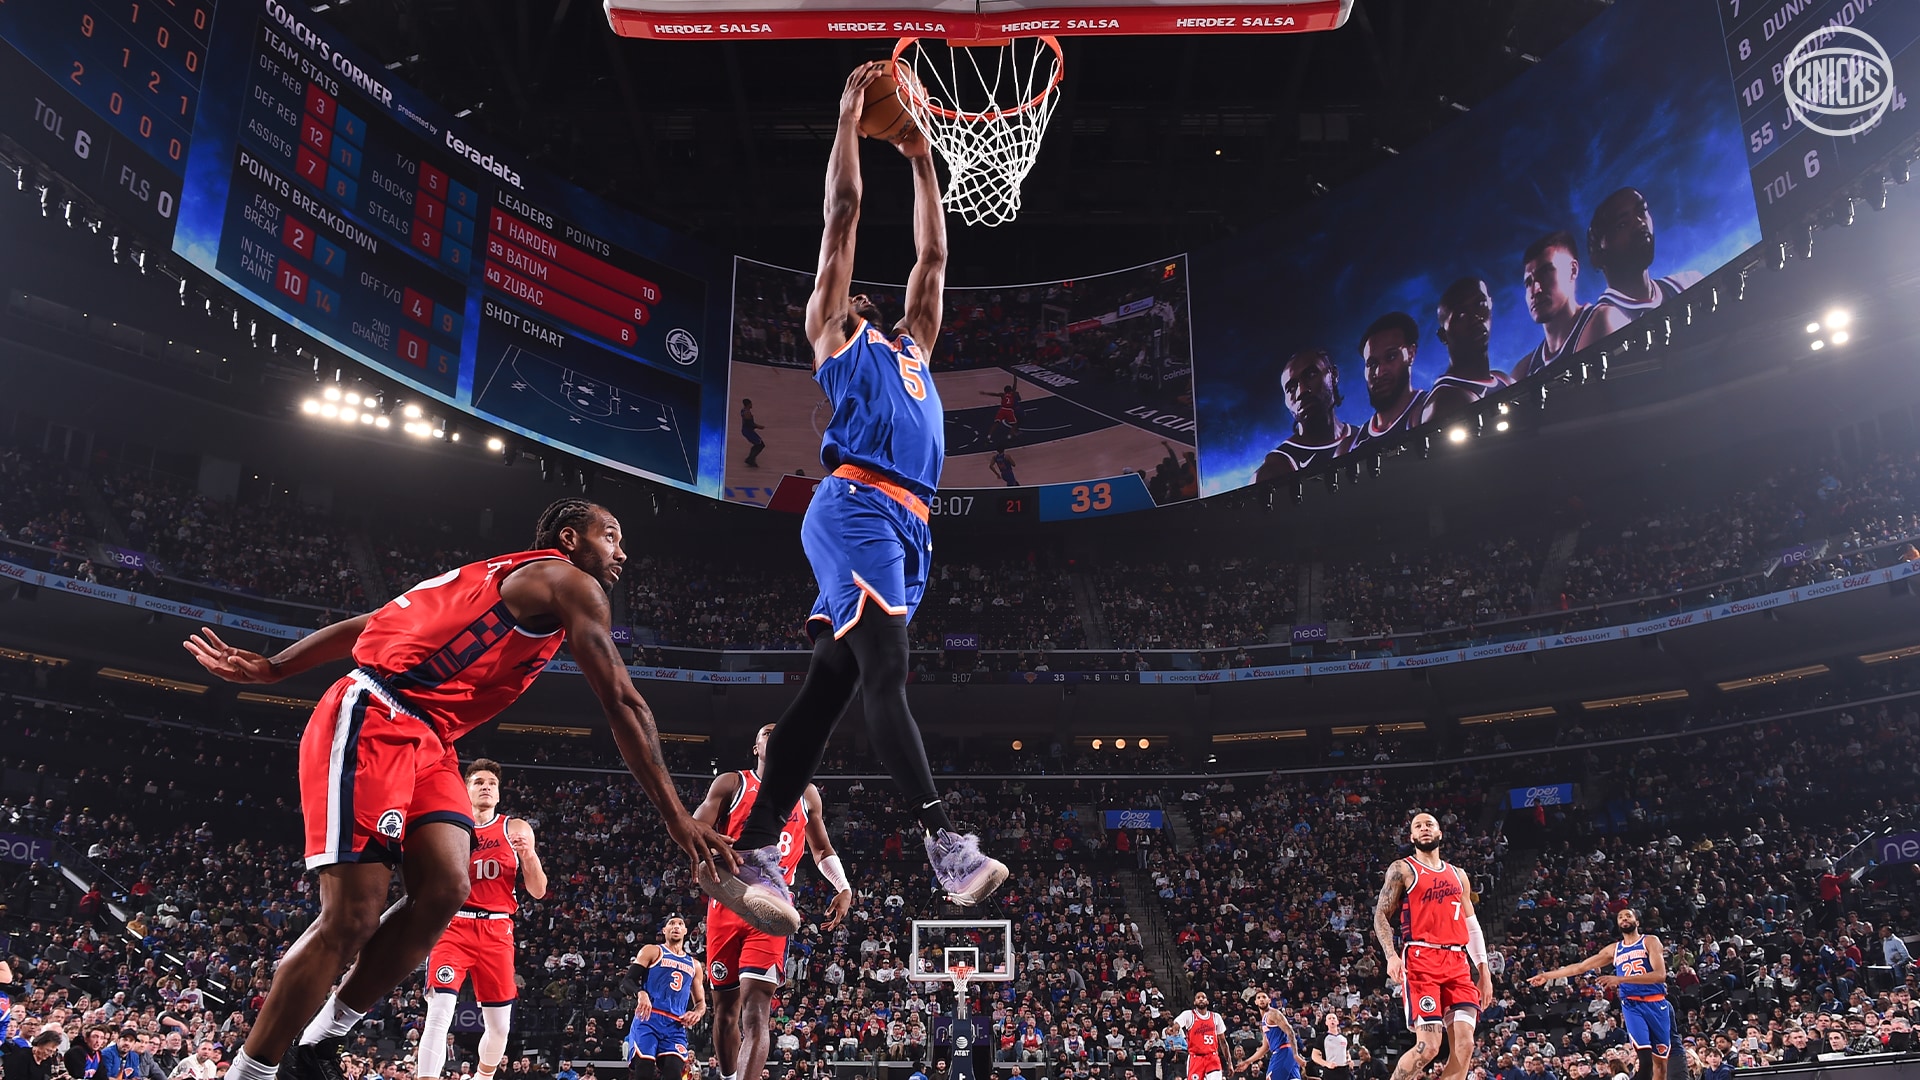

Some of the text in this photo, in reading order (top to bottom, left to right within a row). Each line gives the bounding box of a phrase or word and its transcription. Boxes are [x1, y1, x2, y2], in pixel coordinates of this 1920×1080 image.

[654, 23, 773, 34] HERDEZ SALSA
[828, 22, 946, 33] HERDEZ SALSA
[1002, 19, 1120, 33] HERDEZ SALSA
[1177, 16, 1295, 28] HERDEZ SALSA
[81, 14, 95, 38] 9
[148, 71, 161, 94] 2
[1738, 38, 1751, 61] 8
[264, 26, 339, 97] TEAM STATS
[265, 0, 330, 60] COACH'S
[332, 51, 393, 109] CORNER
[398, 104, 429, 129] presented
[428, 124, 438, 135] by
[70, 61, 85, 86] 2
[260, 54, 280, 76] OFF
[282, 72, 302, 95] REB
[316, 98, 325, 114] 3
[1742, 78, 1764, 107] 10
[1891, 85, 1908, 112] 4
[254, 85, 275, 108] DEF
[277, 102, 297, 126] REB
[310, 126, 324, 148] 12
[34, 97, 92, 160] TOL 6
[1751, 121, 1774, 153] 55
[248, 118, 292, 158] ASSISTS
[308, 159, 317, 175] 7
[397, 153, 415, 175] T/O
[429, 174, 438, 189] 5
[1763, 150, 1820, 205] TOL 6
[119, 164, 174, 219] FLS 0
[372, 170, 413, 205] BLOCKS
[427, 204, 433, 218] 1
[240, 152, 378, 254] POINTS BREAKDOWN
[255, 194, 281, 221] FAST
[498, 190, 553, 230] LEADERS
[244, 205, 279, 238] BREAK
[369, 200, 409, 235] STEALS
[422, 232, 431, 247] 3
[292, 228, 335, 266] 2 7
[566, 225, 611, 257] POINTS
[241, 236, 275, 268] IN THE
[496, 216, 655, 300] 1 HARDEN 10
[241, 255, 273, 284] PAINT
[489, 241, 642, 320] 33 BATUM 8
[284, 271, 332, 313] 10 14
[360, 271, 381, 293] OFF
[382, 284, 401, 304] T/O
[412, 299, 422, 317] 4
[487, 267, 629, 341] 40 ZUBAC 6
[352, 321, 390, 351] CHANCE
[371, 318, 391, 337] 2ND
[485, 302, 565, 349] SHOT CHART
[897, 352, 926, 401] 5
[1124, 406, 1158, 419] LA
[930, 496, 1021, 516] 9:07 21
[1071, 483, 1112, 513] 33
[66, 581, 117, 599] Coors LIGHT
[1808, 575, 1872, 596] CHOOSE Chill
[145, 600, 206, 619] CHOOSE Chill
[1730, 598, 1779, 613] Coors LIGHT
[240, 619, 287, 637] Coors LIGHT
[1293, 627, 1327, 639] neat.
[1637, 614, 1694, 633] CHOOSE Chill
[609, 630, 629, 640] eat.
[945, 637, 977, 647] neat.
[1563, 632, 1610, 645] Coors LIGHT
[1473, 641, 1528, 657] CHOOSE Chill
[1318, 660, 1372, 672] CHOOSE Chill
[1405, 657, 1428, 666] Coors
[655, 669, 678, 679] Chill
[710, 673, 731, 682] Coors
[952, 673, 971, 682] 9:07
[1053, 673, 1065, 681] 33
[1198, 673, 1221, 681] Chill
[1253, 669, 1275, 678] Coors
[1526, 787, 1558, 799] Open
[1120, 810, 1150, 822] Open
[473, 859, 500, 880] 10
[1422, 884, 1461, 904] Angeles
[1433, 878, 1451, 889] Los
[1451, 901, 1461, 920] 7
[1622, 958, 1647, 977] 25
[670, 971, 683, 991] 3
[1203, 1034, 1214, 1045] 55
